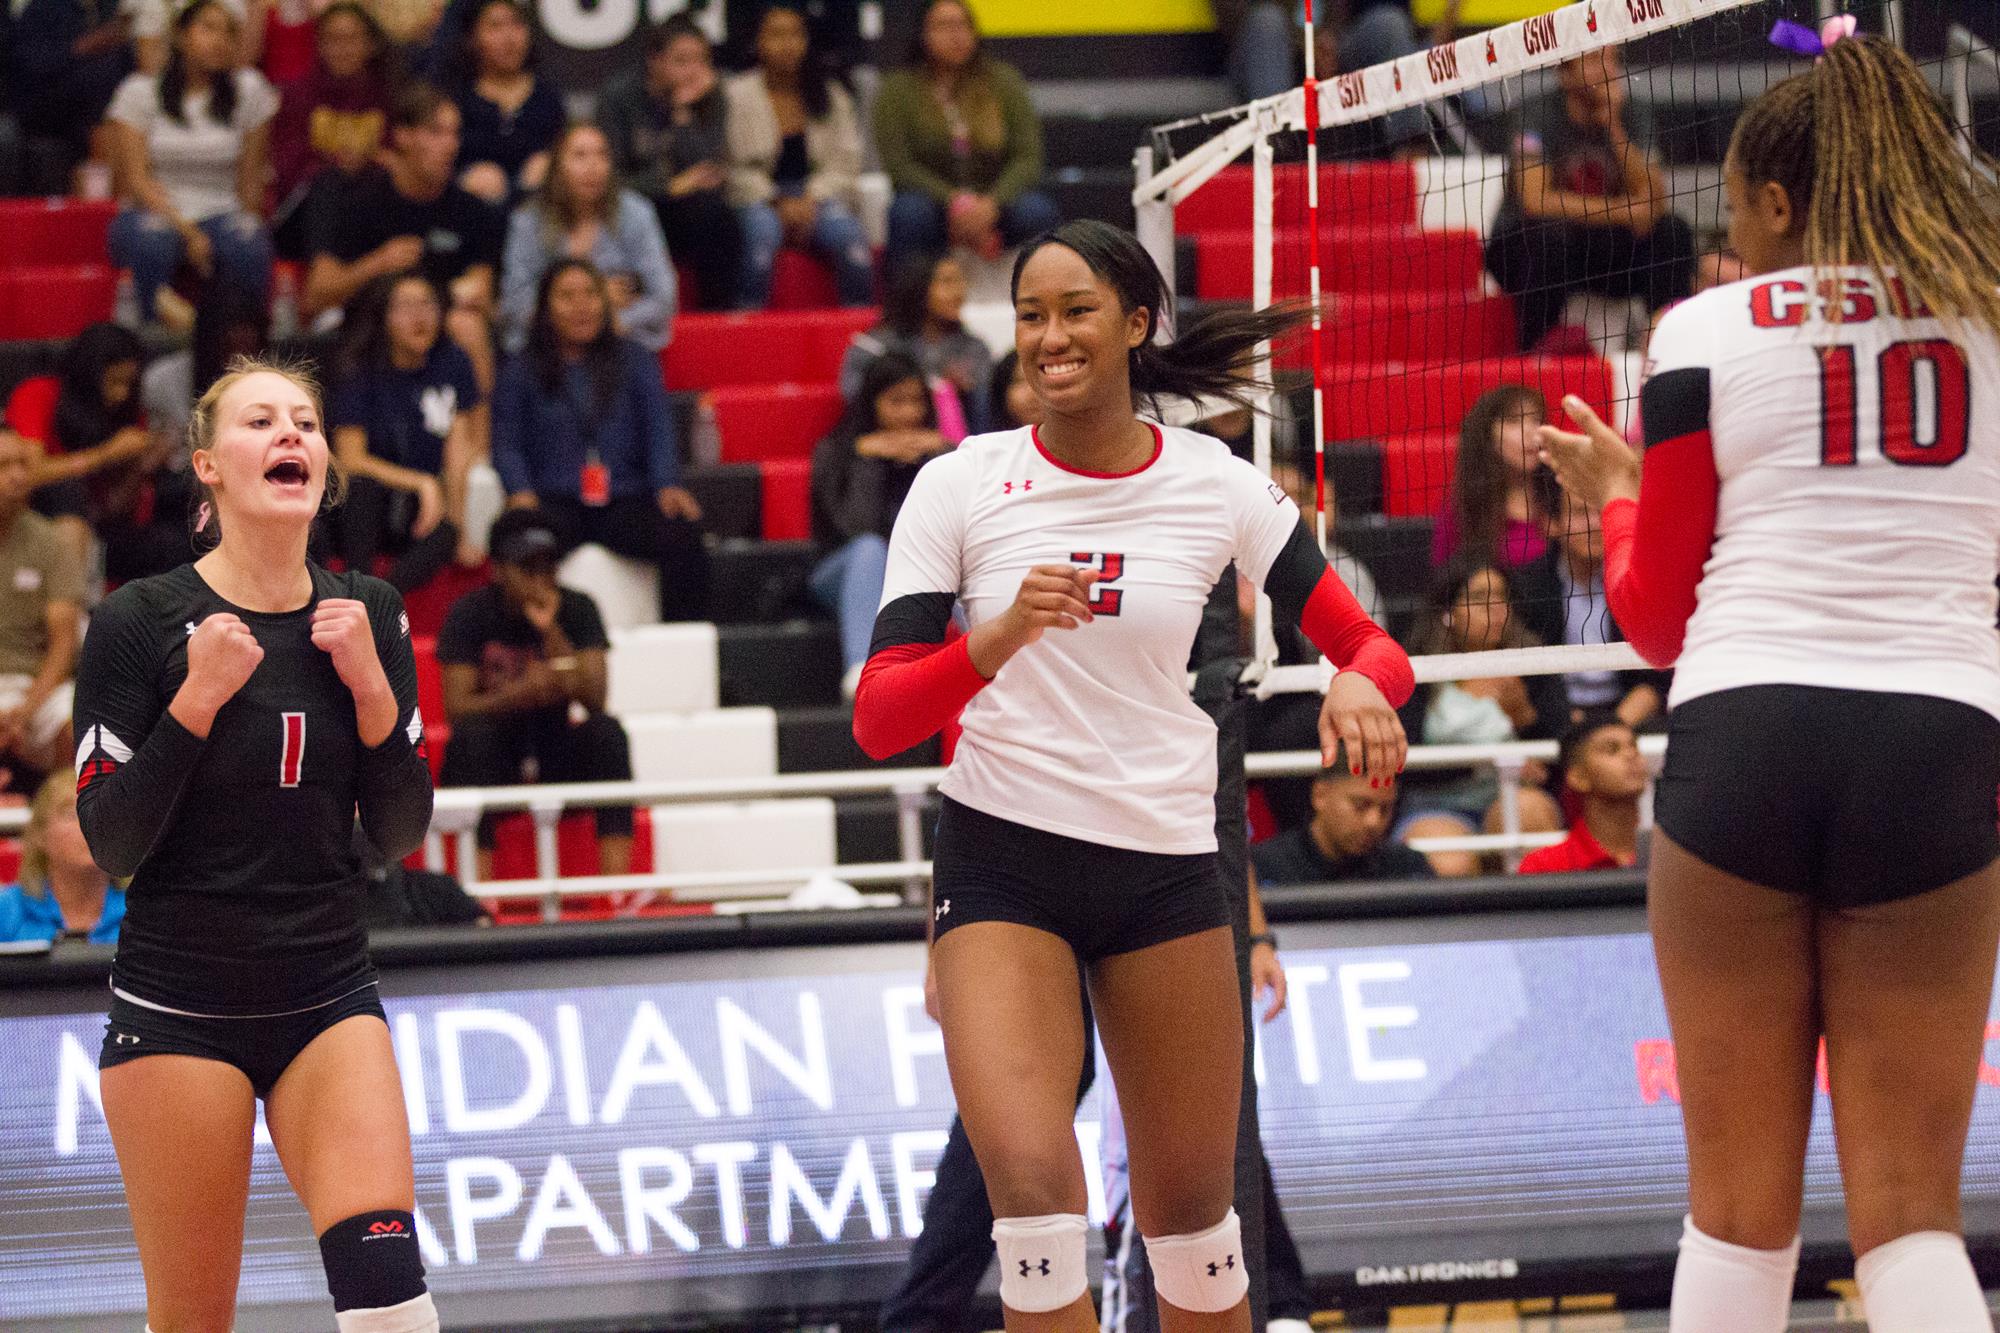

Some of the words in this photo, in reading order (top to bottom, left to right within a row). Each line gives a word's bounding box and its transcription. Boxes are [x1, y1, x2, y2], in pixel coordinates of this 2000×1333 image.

[1426, 42, 1460, 85] CSUN
[1522, 12, 1559, 55] CSUN
[1812, 338, 1971, 467] 10
[1069, 551, 1124, 617] 2
[280, 712, 306, 788] 1
